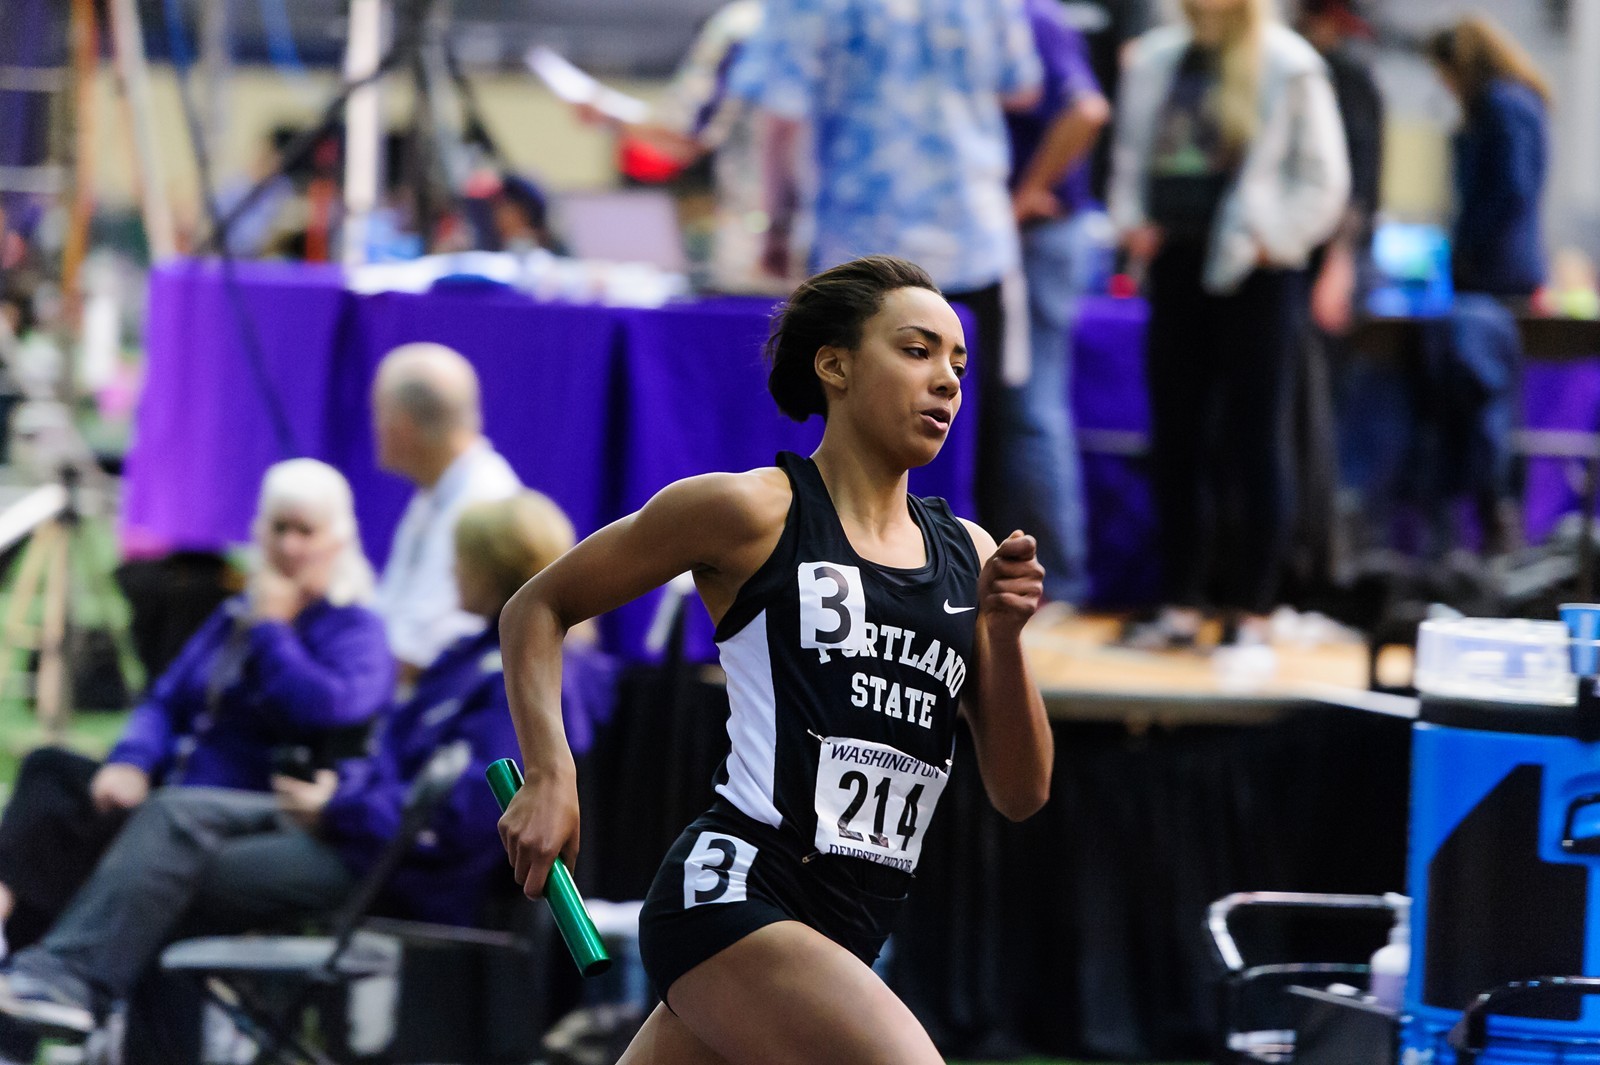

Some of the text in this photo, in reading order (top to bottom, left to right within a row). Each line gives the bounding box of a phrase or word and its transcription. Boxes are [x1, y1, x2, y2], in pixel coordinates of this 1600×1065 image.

[813, 566, 852, 644] 3
[818, 622, 967, 699] RTLAND
[850, 671, 937, 730] STATE
[837, 770, 925, 852] 214
[694, 838, 737, 903] 3
